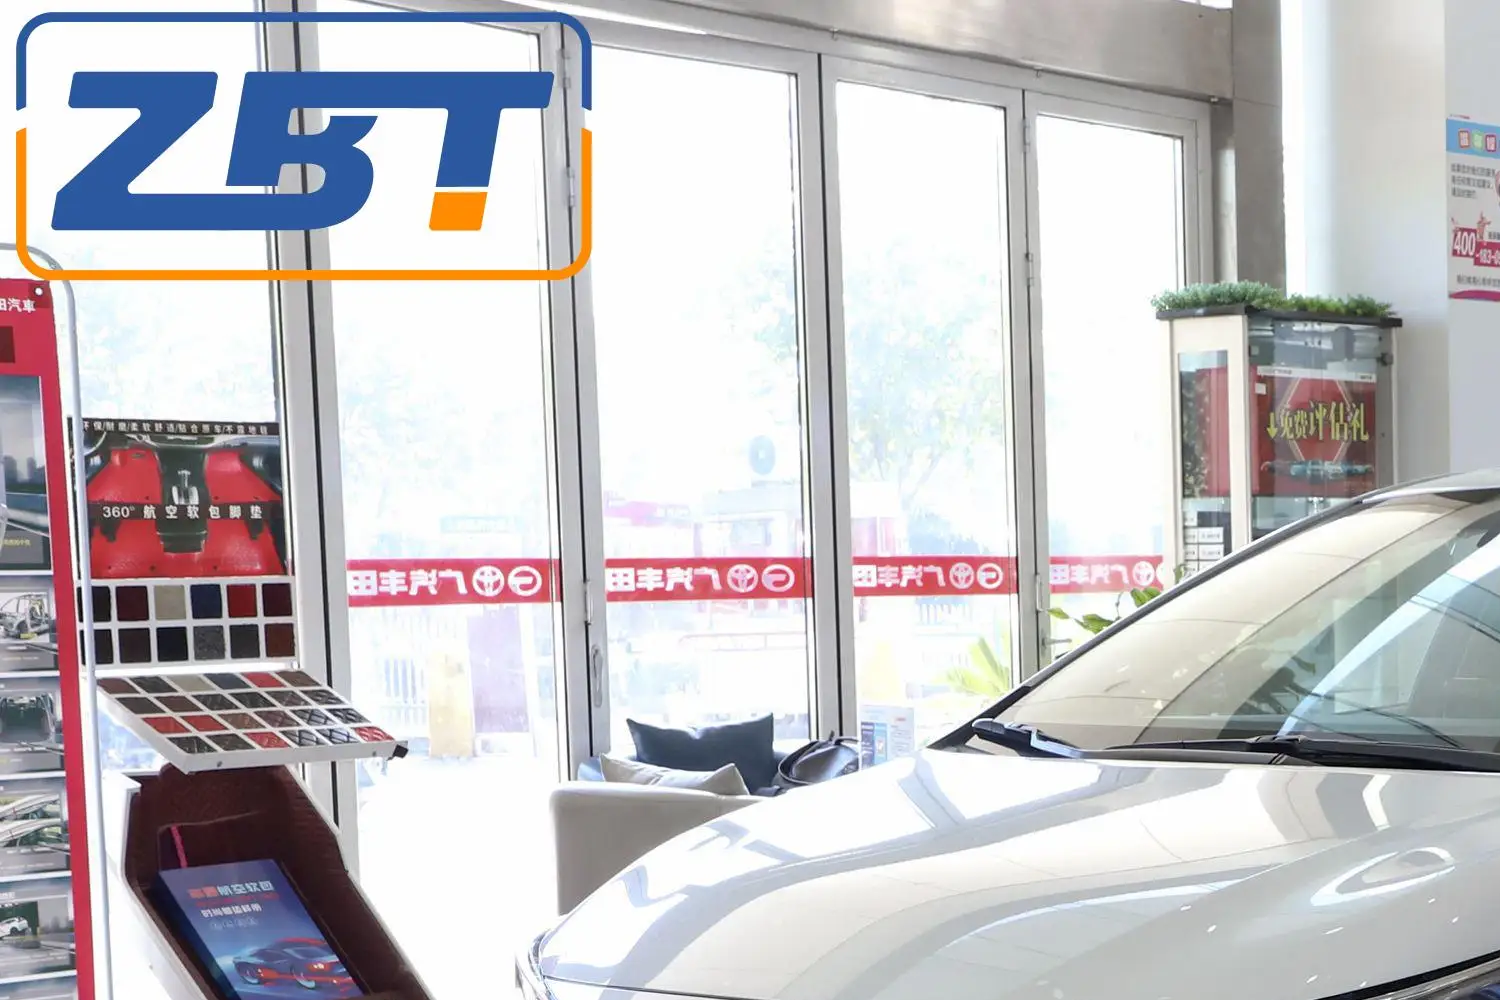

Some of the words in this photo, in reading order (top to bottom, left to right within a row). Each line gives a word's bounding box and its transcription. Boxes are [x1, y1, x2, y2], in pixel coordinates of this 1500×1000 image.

[1453, 231, 1476, 256] 400
[1280, 400, 1369, 442] 免费评估礼
[143, 504, 263, 520] 航空软包脚垫
